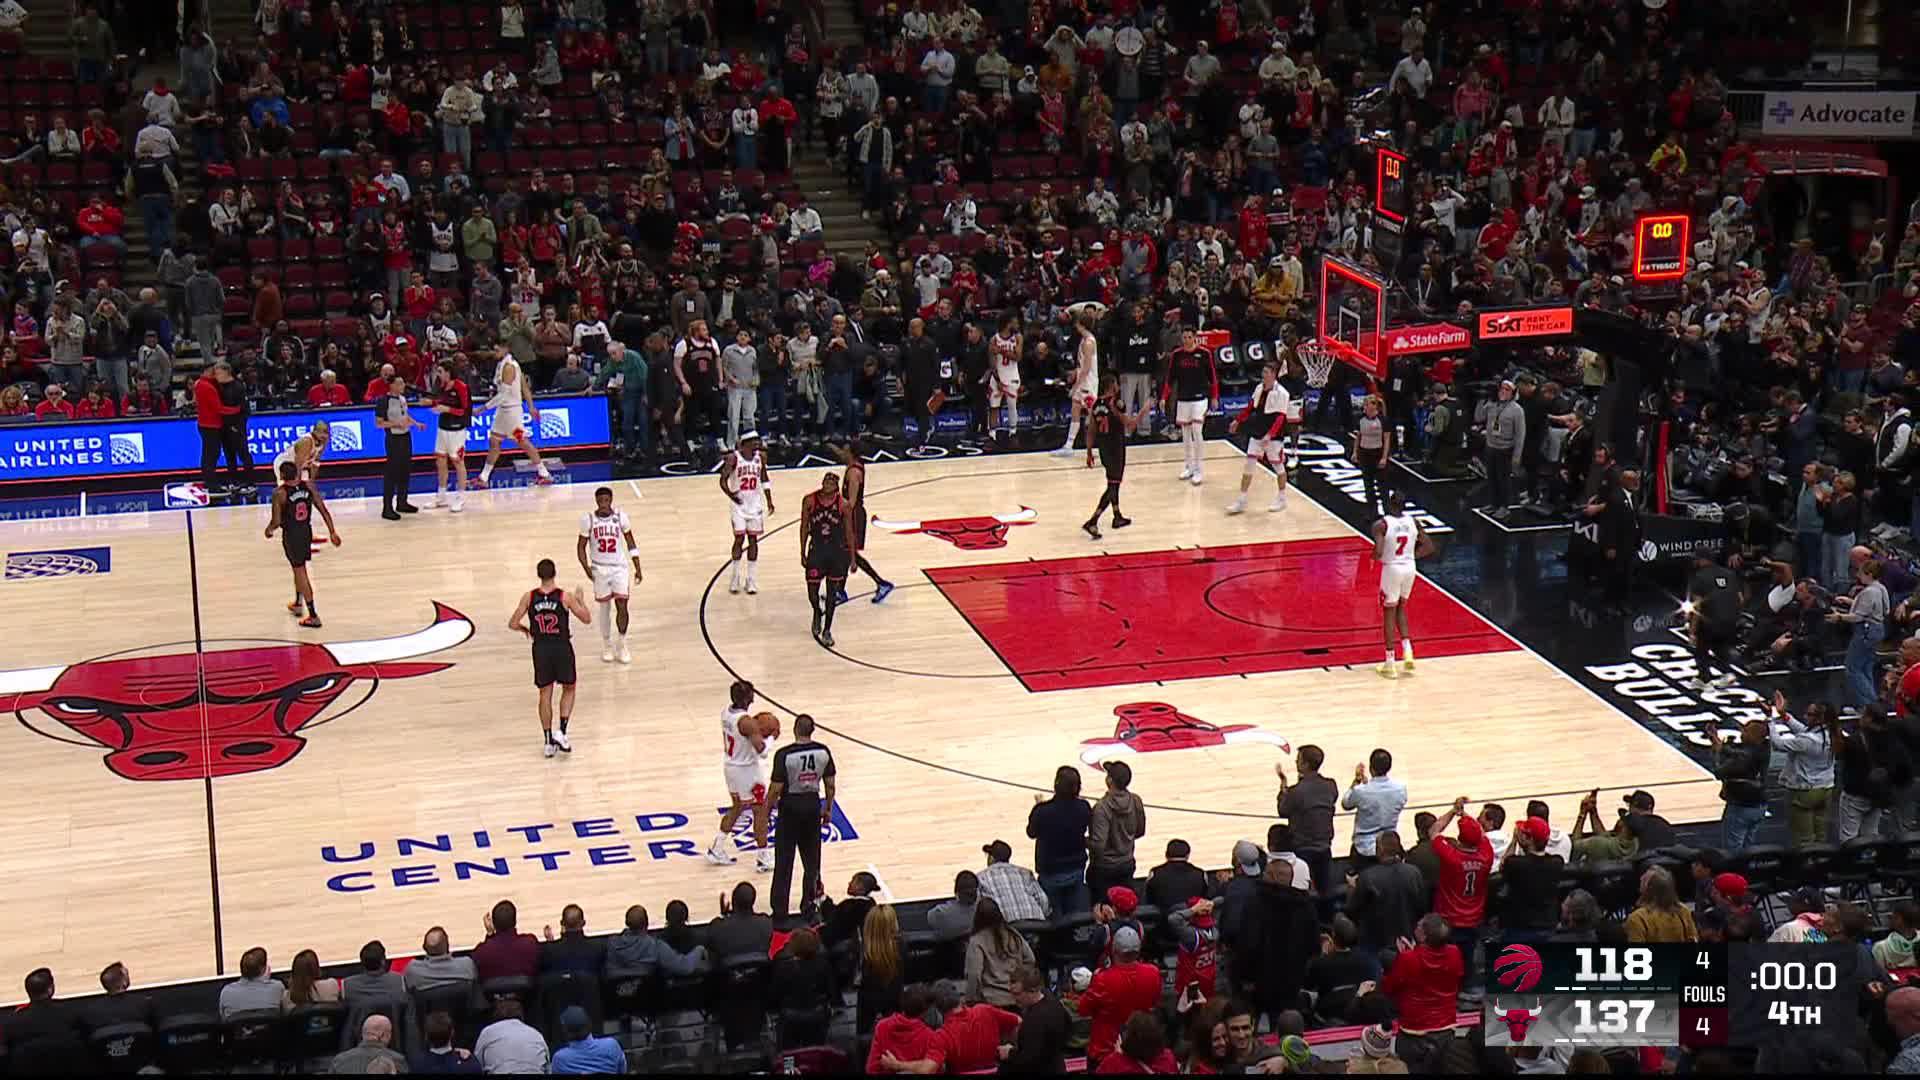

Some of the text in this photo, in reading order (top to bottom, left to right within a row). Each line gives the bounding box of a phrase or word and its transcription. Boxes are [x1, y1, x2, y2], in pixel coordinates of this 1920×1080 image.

[1800, 102, 1905, 123] Advocate
[1526, 315, 1550, 323] RENT
[1527, 321, 1566, 332] THE CAR
[15, 437, 102, 453] UNITED
[740, 477, 758, 490] 20
[593, 525, 620, 539] BULLS
[821, 523, 831, 535] 2
[598, 539, 617, 553] 32
[1395, 536, 1408, 555] 7
[1659, 541, 1692, 552] WIND
[534, 612, 560, 634] 12
[799, 754, 816, 772] 74
[321, 812, 689, 862] UNITED
[326, 839, 702, 892] CENTER
